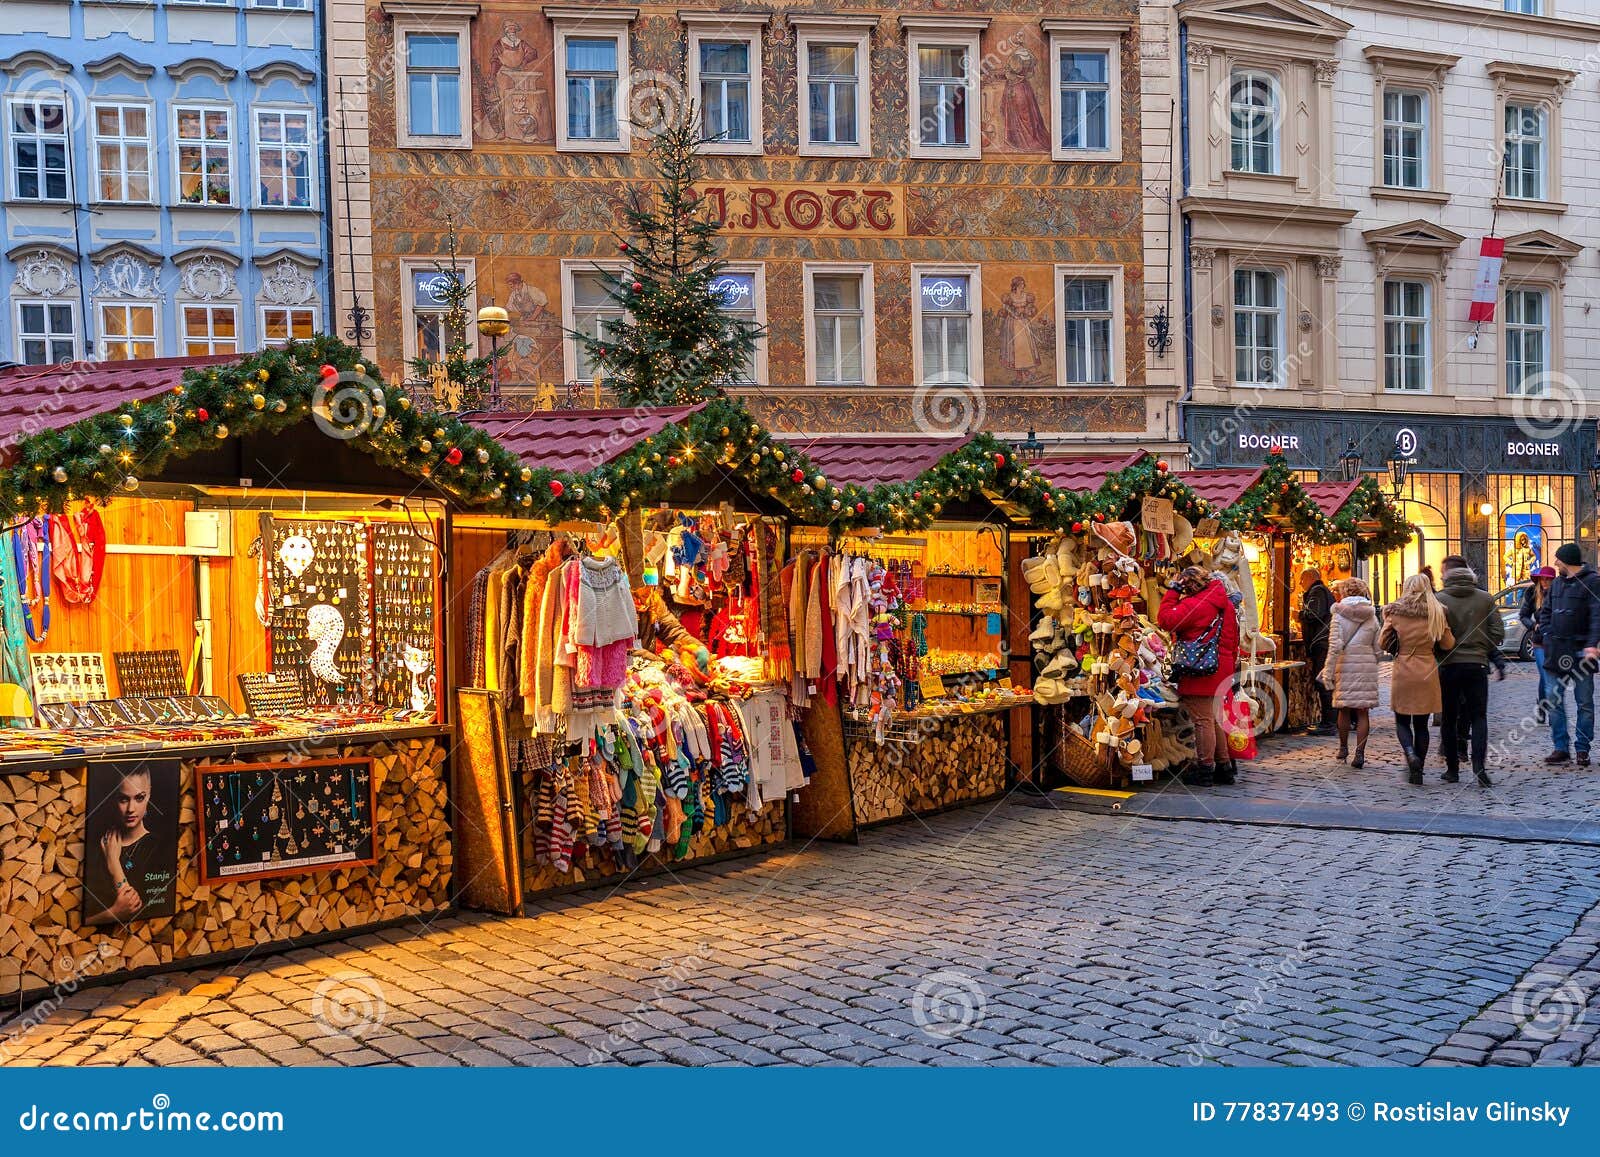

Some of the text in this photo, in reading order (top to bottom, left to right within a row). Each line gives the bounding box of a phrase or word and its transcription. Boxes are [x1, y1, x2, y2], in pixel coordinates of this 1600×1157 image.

[922, 286, 962, 297] Hard Rock
[1239, 434, 1299, 449] BOGNER
[1507, 442, 1560, 456] BOGNER
[145, 870, 170, 882] Stanja
